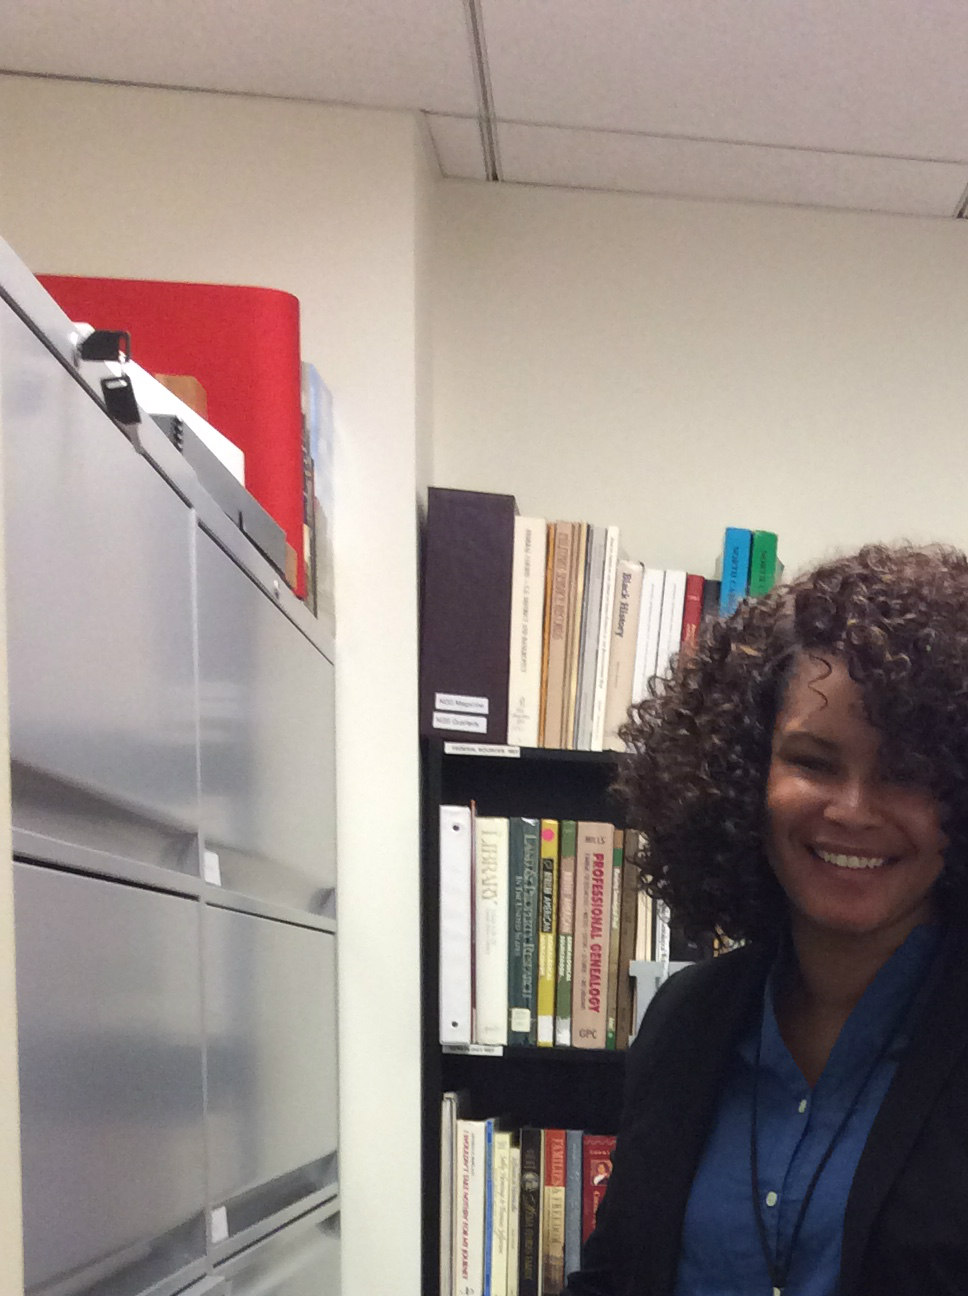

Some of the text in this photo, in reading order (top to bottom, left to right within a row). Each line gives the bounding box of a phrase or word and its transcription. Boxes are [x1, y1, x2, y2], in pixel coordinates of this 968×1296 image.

[614, 573, 632, 638] Black History
[588, 853, 605, 1014] PROFESSIONAL GENEALOGY
[578, 1028, 598, 1040] GPC
